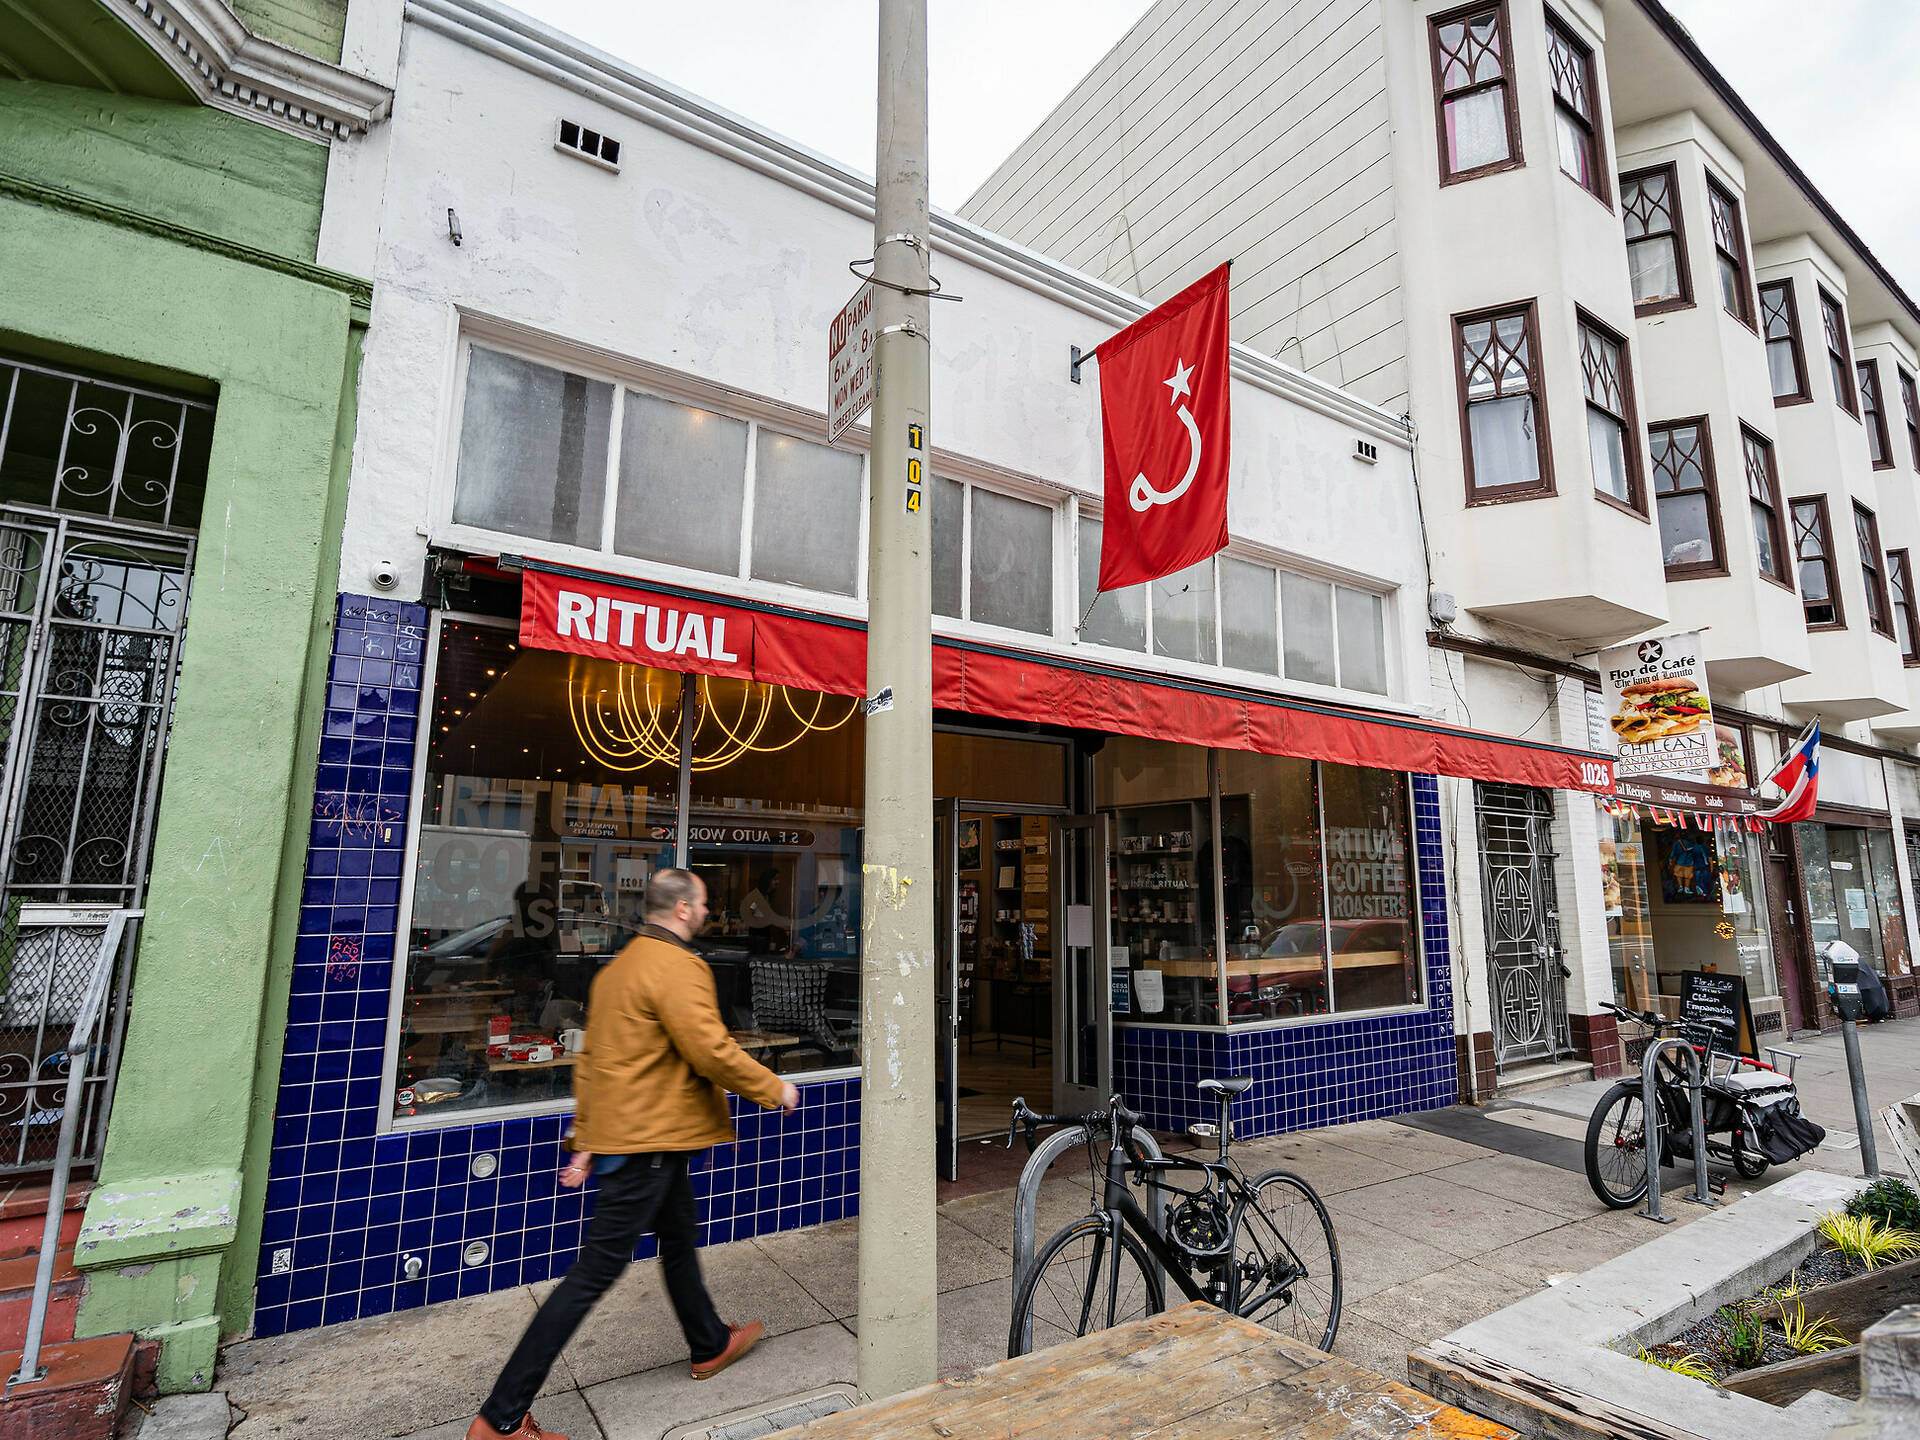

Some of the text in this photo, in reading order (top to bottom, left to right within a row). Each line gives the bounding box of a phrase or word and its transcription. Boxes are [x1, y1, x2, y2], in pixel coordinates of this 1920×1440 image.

[831, 285, 875, 355] NO PARKI
[833, 360, 841, 383] 6
[861, 328, 869, 353] 8
[834, 383, 848, 412] MON
[850, 366, 865, 396] WED
[832, 386, 873, 435] STREET CLEAN
[556, 590, 738, 663] RITUAL
[1609, 655, 1696, 681] Flor de Café
[1614, 680, 1631, 689] The
[1632, 675, 1652, 686] king
[1651, 673, 1660, 683] of
[1619, 734, 1706, 757] CHILEAN
[1620, 749, 1708, 766] SANDWICH SHOP
[1580, 762, 1610, 787] 1026
[1620, 757, 1708, 773] SAN FRANCISCO
[445, 774, 653, 840] RITUAL
[1626, 785, 1652, 801] Recipes
[1661, 789, 1697, 805] Sandwiches
[1705, 795, 1724, 808] Salads
[1329, 826, 1404, 860] RITUAL
[1158, 880, 1190, 888] RITUAL
[1331, 861, 1406, 893] COFFEE
[1333, 894, 1408, 918] ROASTERS
